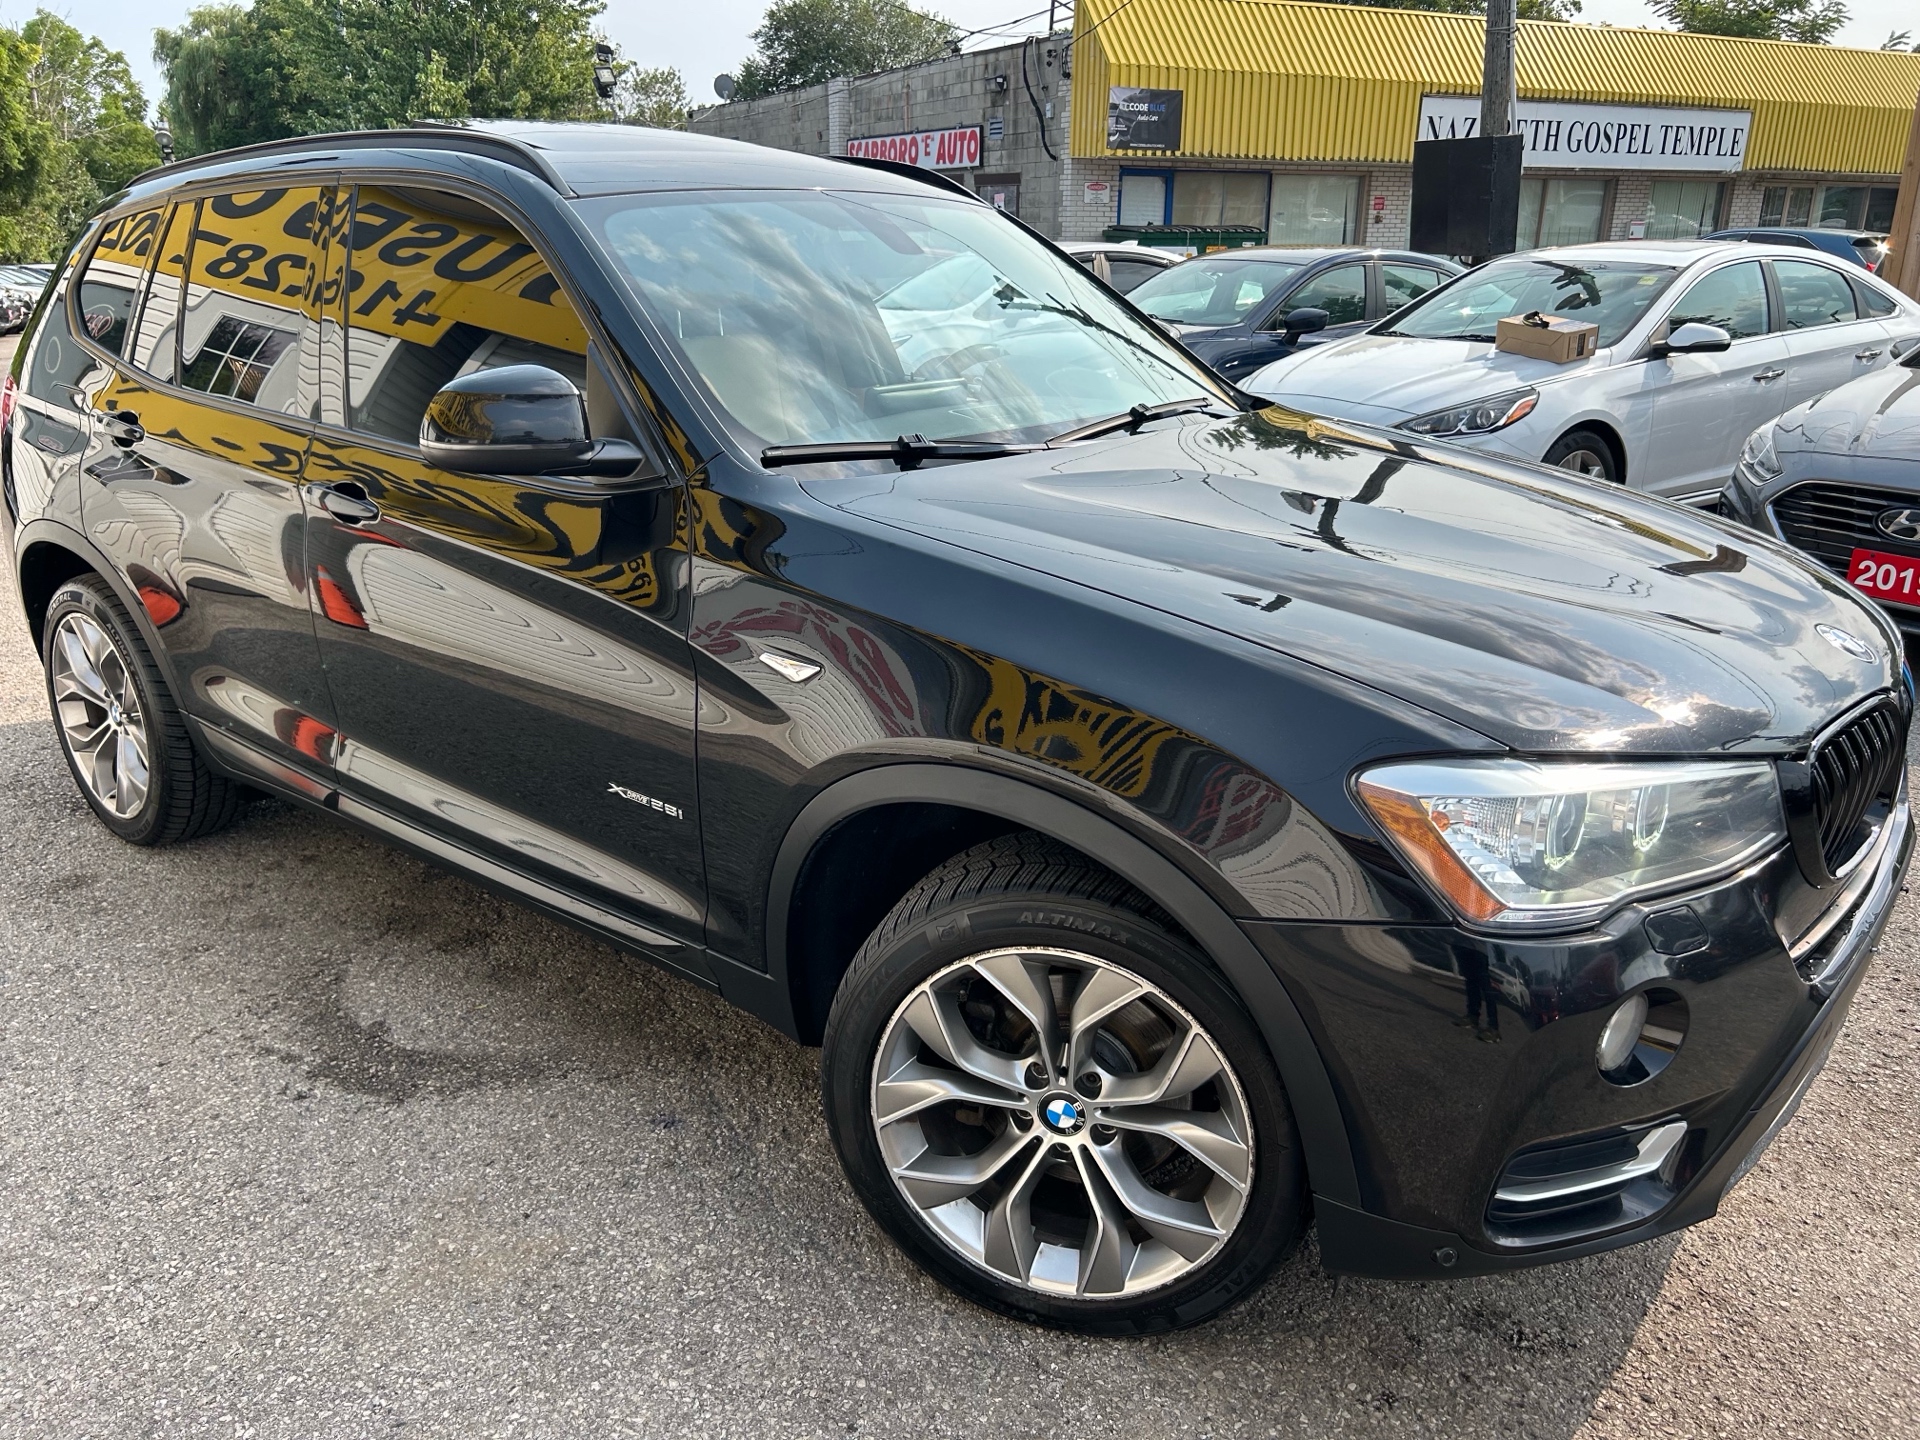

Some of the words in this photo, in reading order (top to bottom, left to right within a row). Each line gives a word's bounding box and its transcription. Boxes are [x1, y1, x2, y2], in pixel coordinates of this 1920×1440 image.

[935, 129, 979, 165] AUTO
[1426, 115, 1563, 152] NAZETH
[1567, 120, 1653, 154] GOSPEL
[1659, 124, 1744, 157] TEMPLE
[1854, 560, 1920, 596] 201
[1016, 911, 1132, 944] ALTIMAX
[1065, 1101, 1086, 1135] BMW
